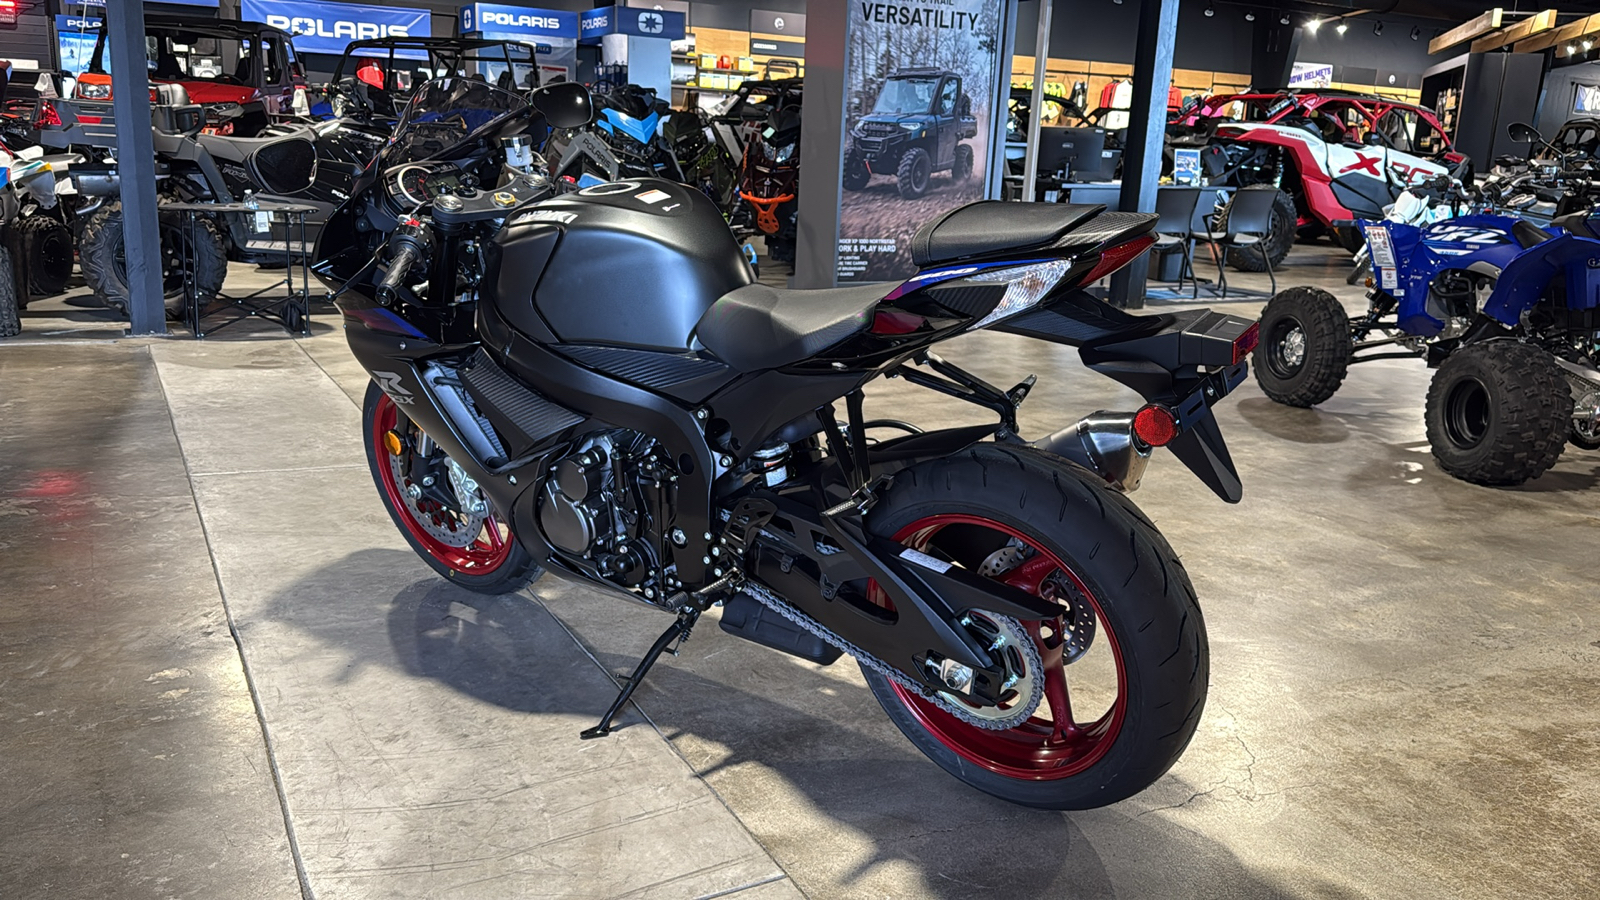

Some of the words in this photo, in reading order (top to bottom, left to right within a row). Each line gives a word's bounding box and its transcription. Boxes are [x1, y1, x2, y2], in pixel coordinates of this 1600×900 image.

[266, 14, 411, 40] POLARIS
[482, 11, 560, 29] POLARIS
[581, 15, 609, 31] POLARIS
[861, 2, 979, 31] VERSATILITY
[1303, 67, 1332, 81] HELMETS
[582, 137, 612, 168] POLARIS
[1339, 151, 1383, 177] X
[512, 210, 579, 224] SUZUKI
[1425, 224, 1502, 244] YFZ
[372, 370, 414, 395] R
